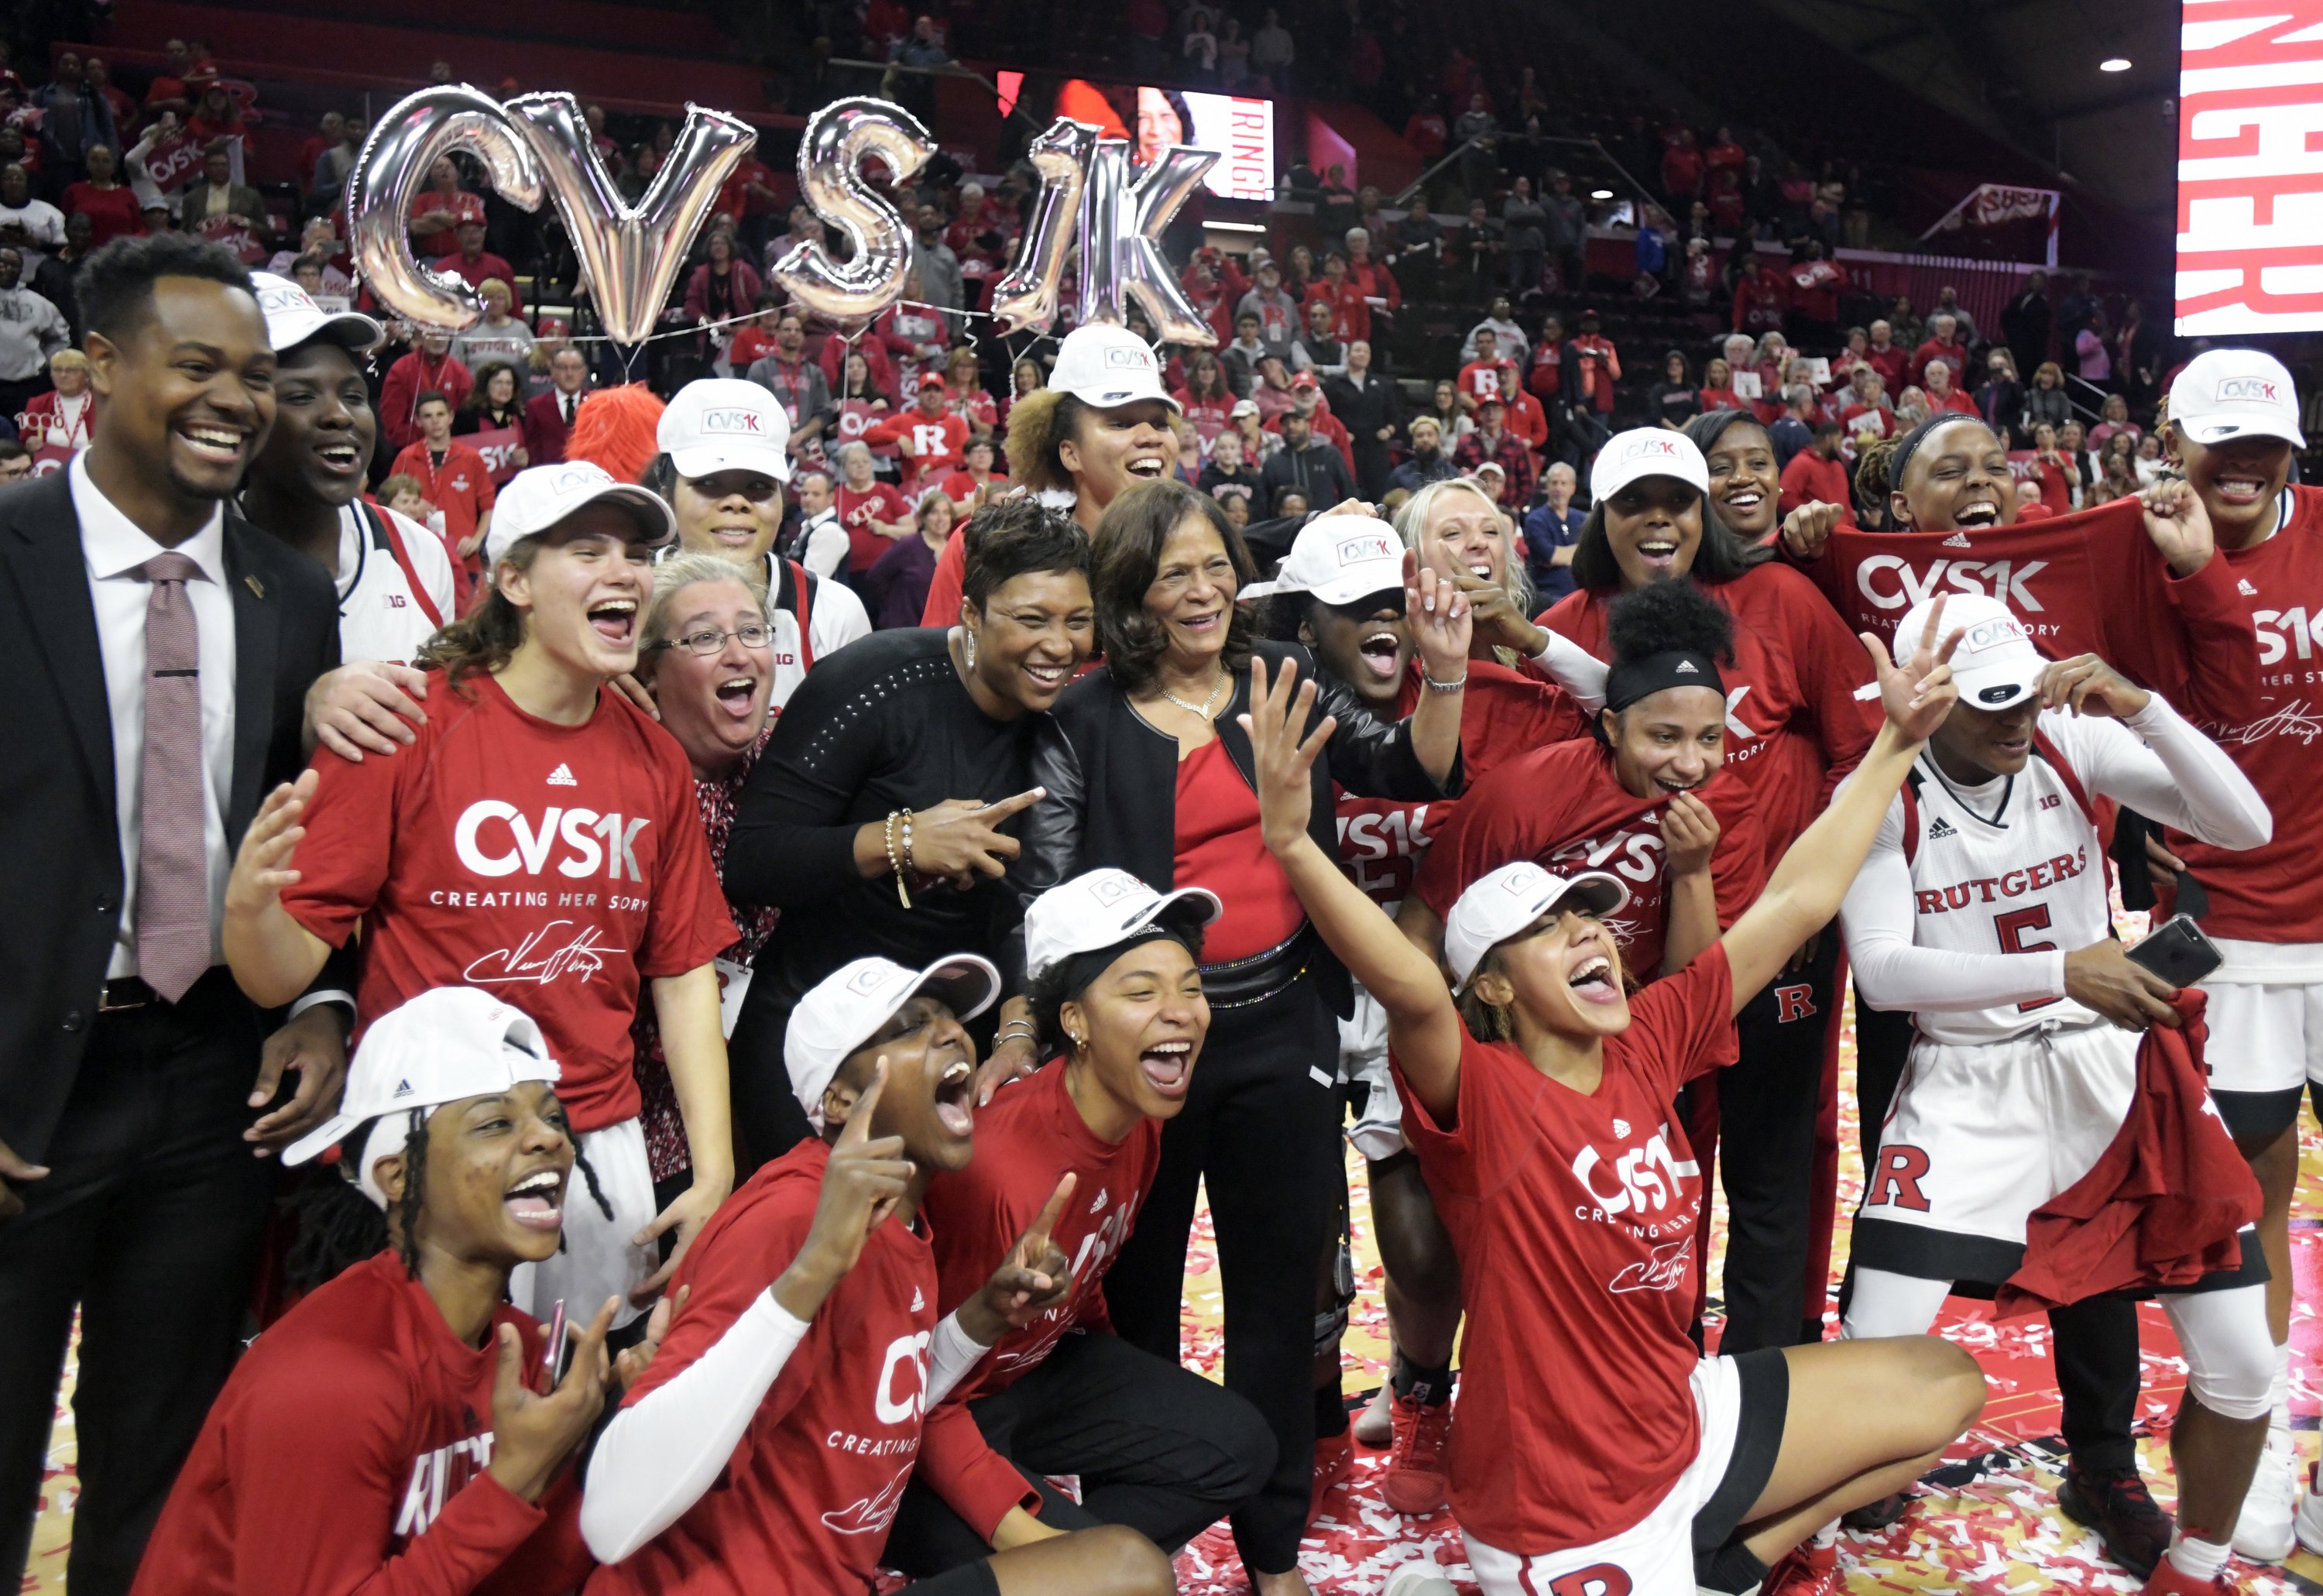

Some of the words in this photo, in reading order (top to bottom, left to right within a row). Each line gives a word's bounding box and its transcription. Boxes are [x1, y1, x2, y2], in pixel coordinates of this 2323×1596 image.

[708, 412, 760, 431] CVS1K
[912, 424, 949, 456] R
[1942, 540, 1971, 548] adidas
[455, 799, 651, 883] CVS1K
[1914, 843, 2087, 915] RUTGERS
[430, 891, 547, 908] CREATING
[558, 893, 598, 907] HER
[1774, 983, 1817, 1023] R
[1868, 1144, 1931, 1213] R
[827, 1430, 918, 1457] CREATING
